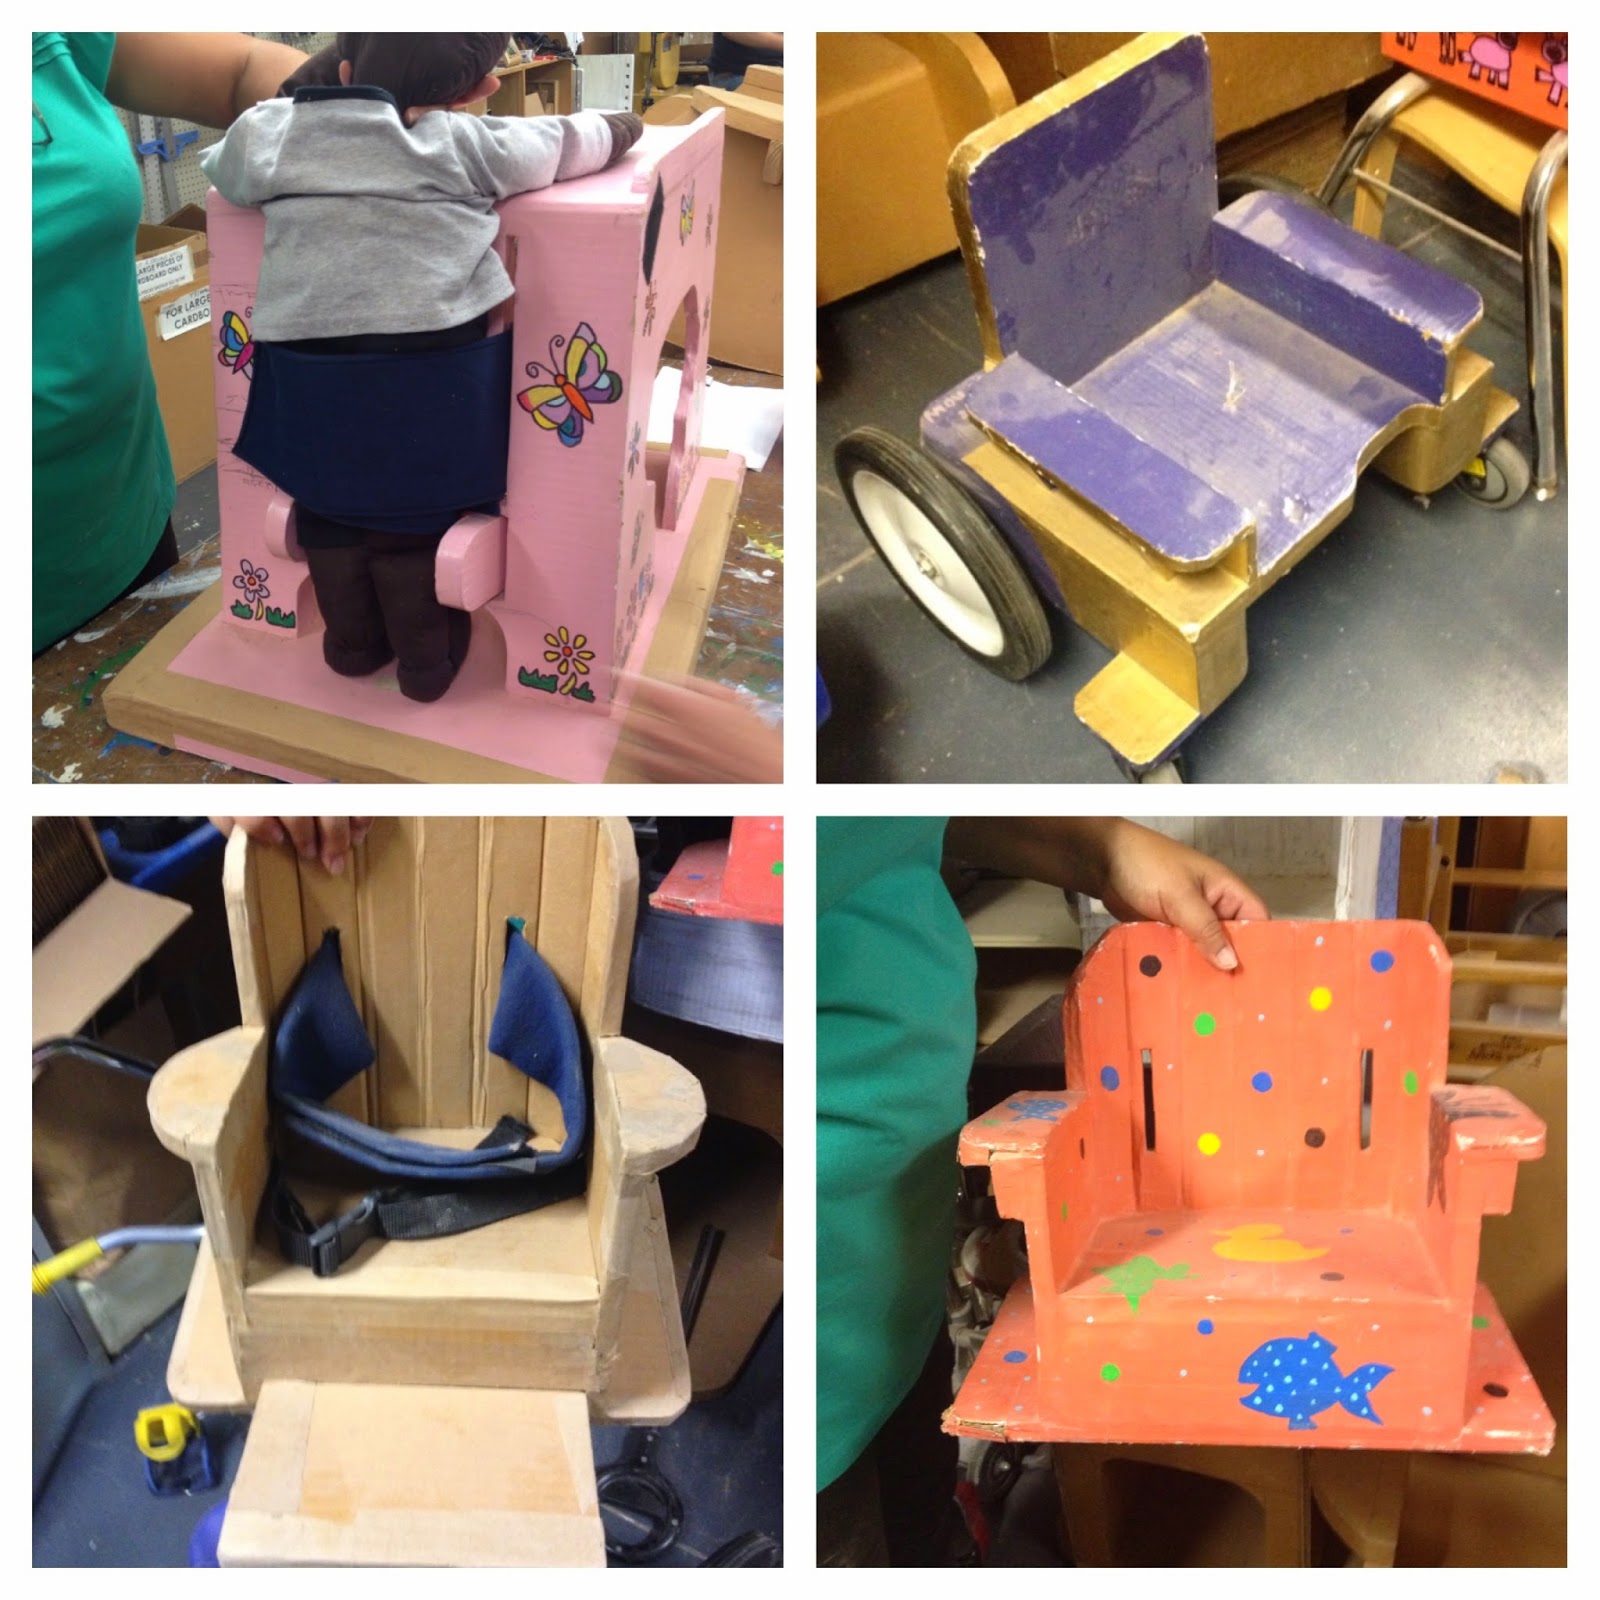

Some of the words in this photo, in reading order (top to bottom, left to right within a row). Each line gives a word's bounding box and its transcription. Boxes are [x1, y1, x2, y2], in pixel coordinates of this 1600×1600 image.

[156, 257, 175, 269] PIECES
[176, 253, 183, 262] OF
[167, 264, 182, 274] ONLY
[166, 305, 182, 319] FOR
[185, 293, 210, 311] LARGE
